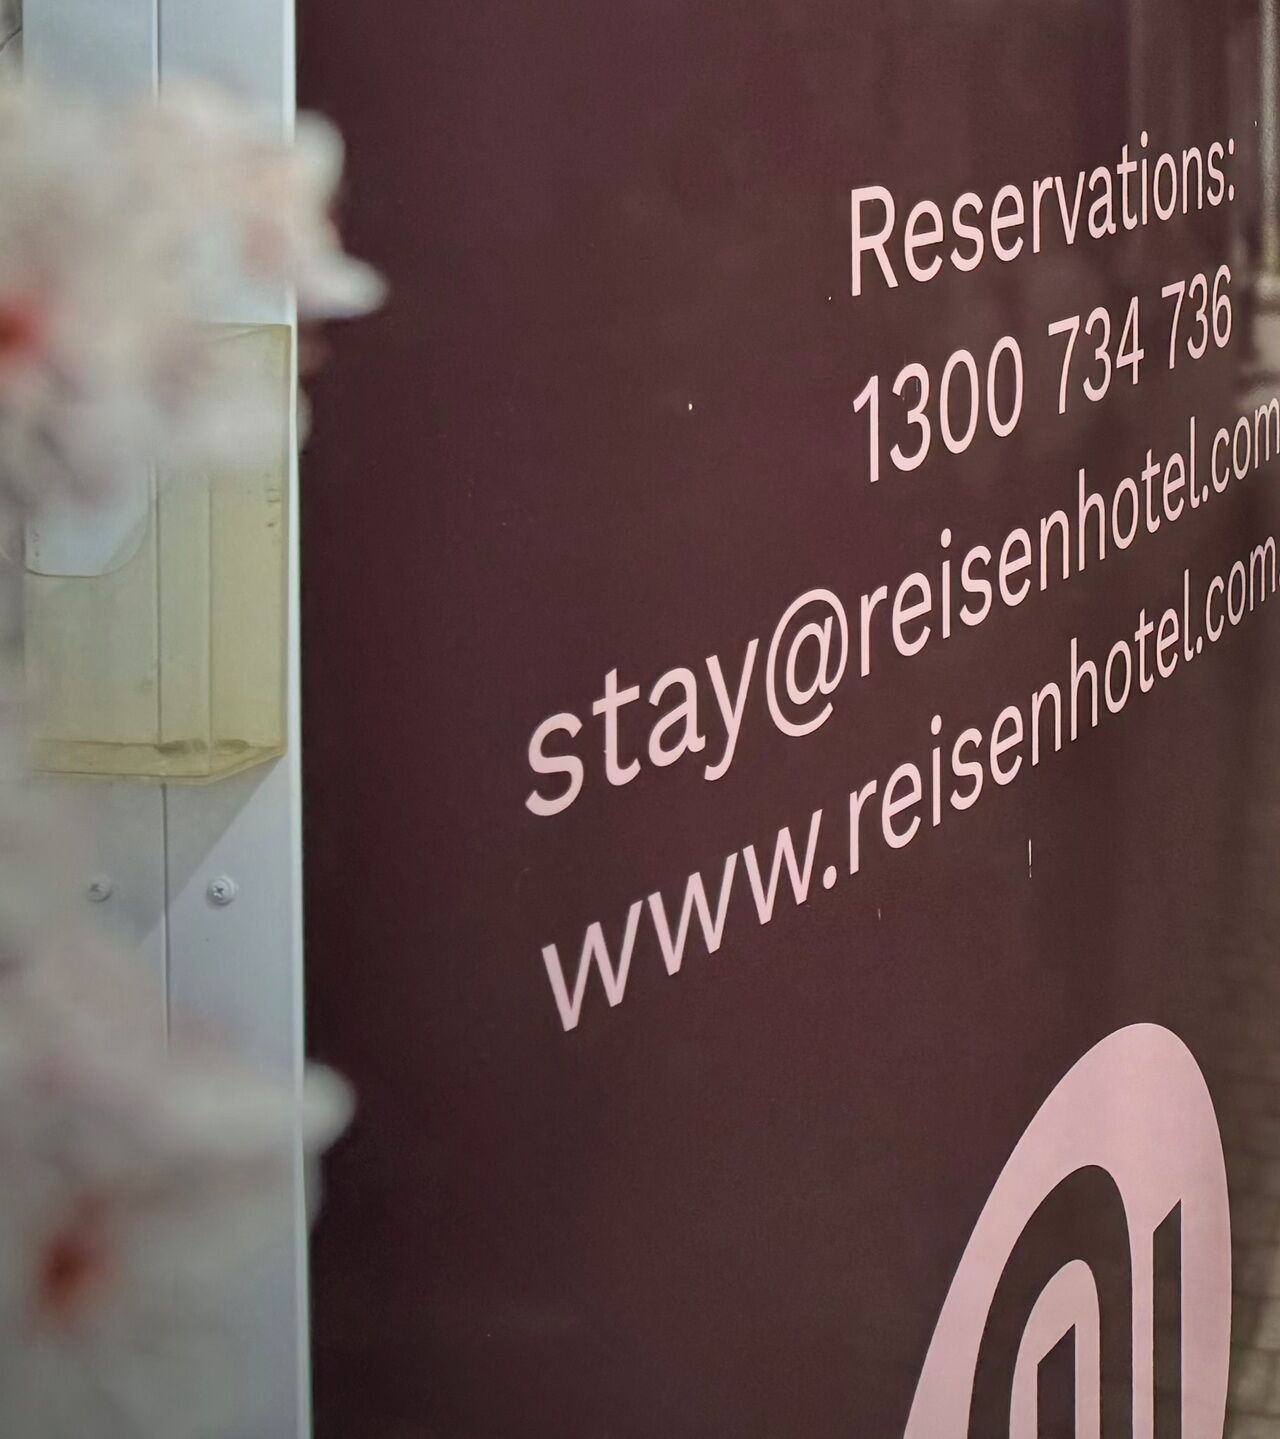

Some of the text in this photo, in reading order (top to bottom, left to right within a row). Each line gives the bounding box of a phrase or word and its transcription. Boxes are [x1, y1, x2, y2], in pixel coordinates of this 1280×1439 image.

[849, 130, 1236, 297] Reservations:
[852, 263, 1234, 484] 1300 734 736
